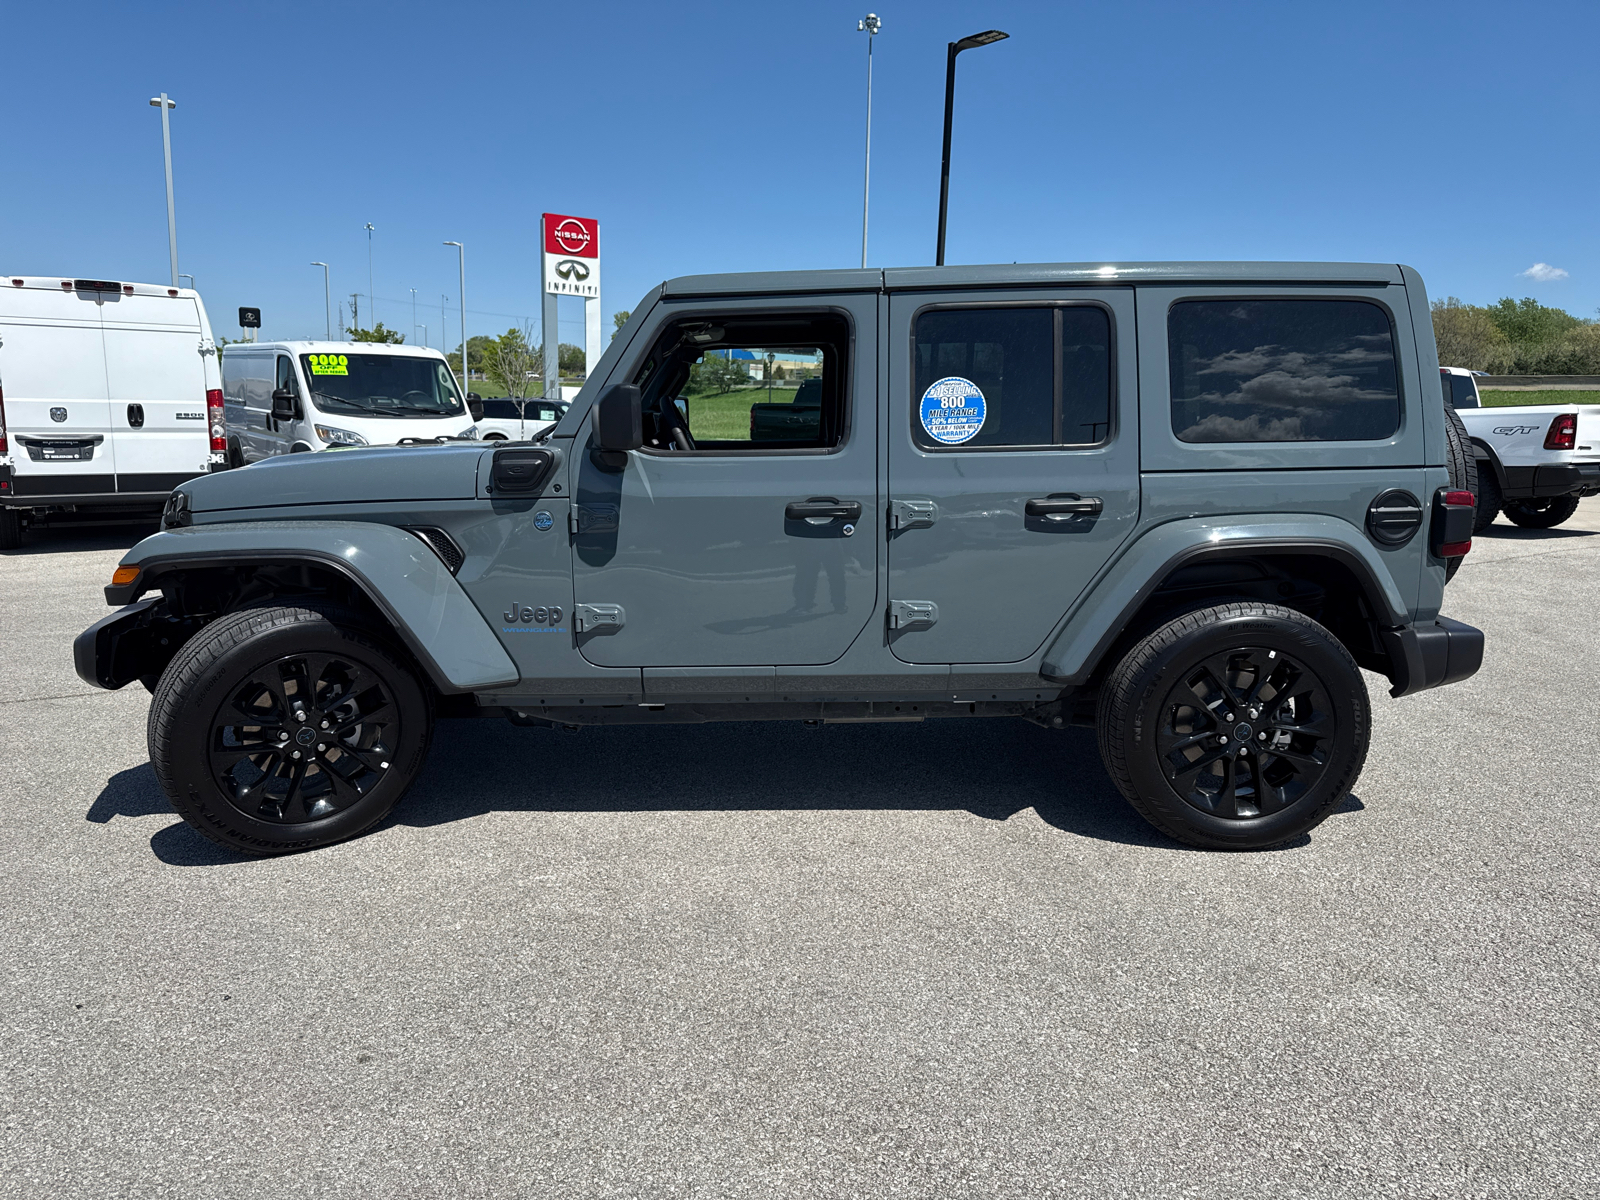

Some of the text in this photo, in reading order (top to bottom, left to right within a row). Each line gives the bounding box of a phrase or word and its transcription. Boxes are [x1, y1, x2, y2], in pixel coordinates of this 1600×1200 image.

[554, 230, 590, 240] NISSAN
[548, 281, 597, 295] INFINITI
[309, 354, 348, 366] 9000
[943, 385, 977, 395] SELLING
[940, 396, 965, 409] 800
[928, 408, 977, 417] MILE RANGE
[503, 601, 564, 627] Jeep
